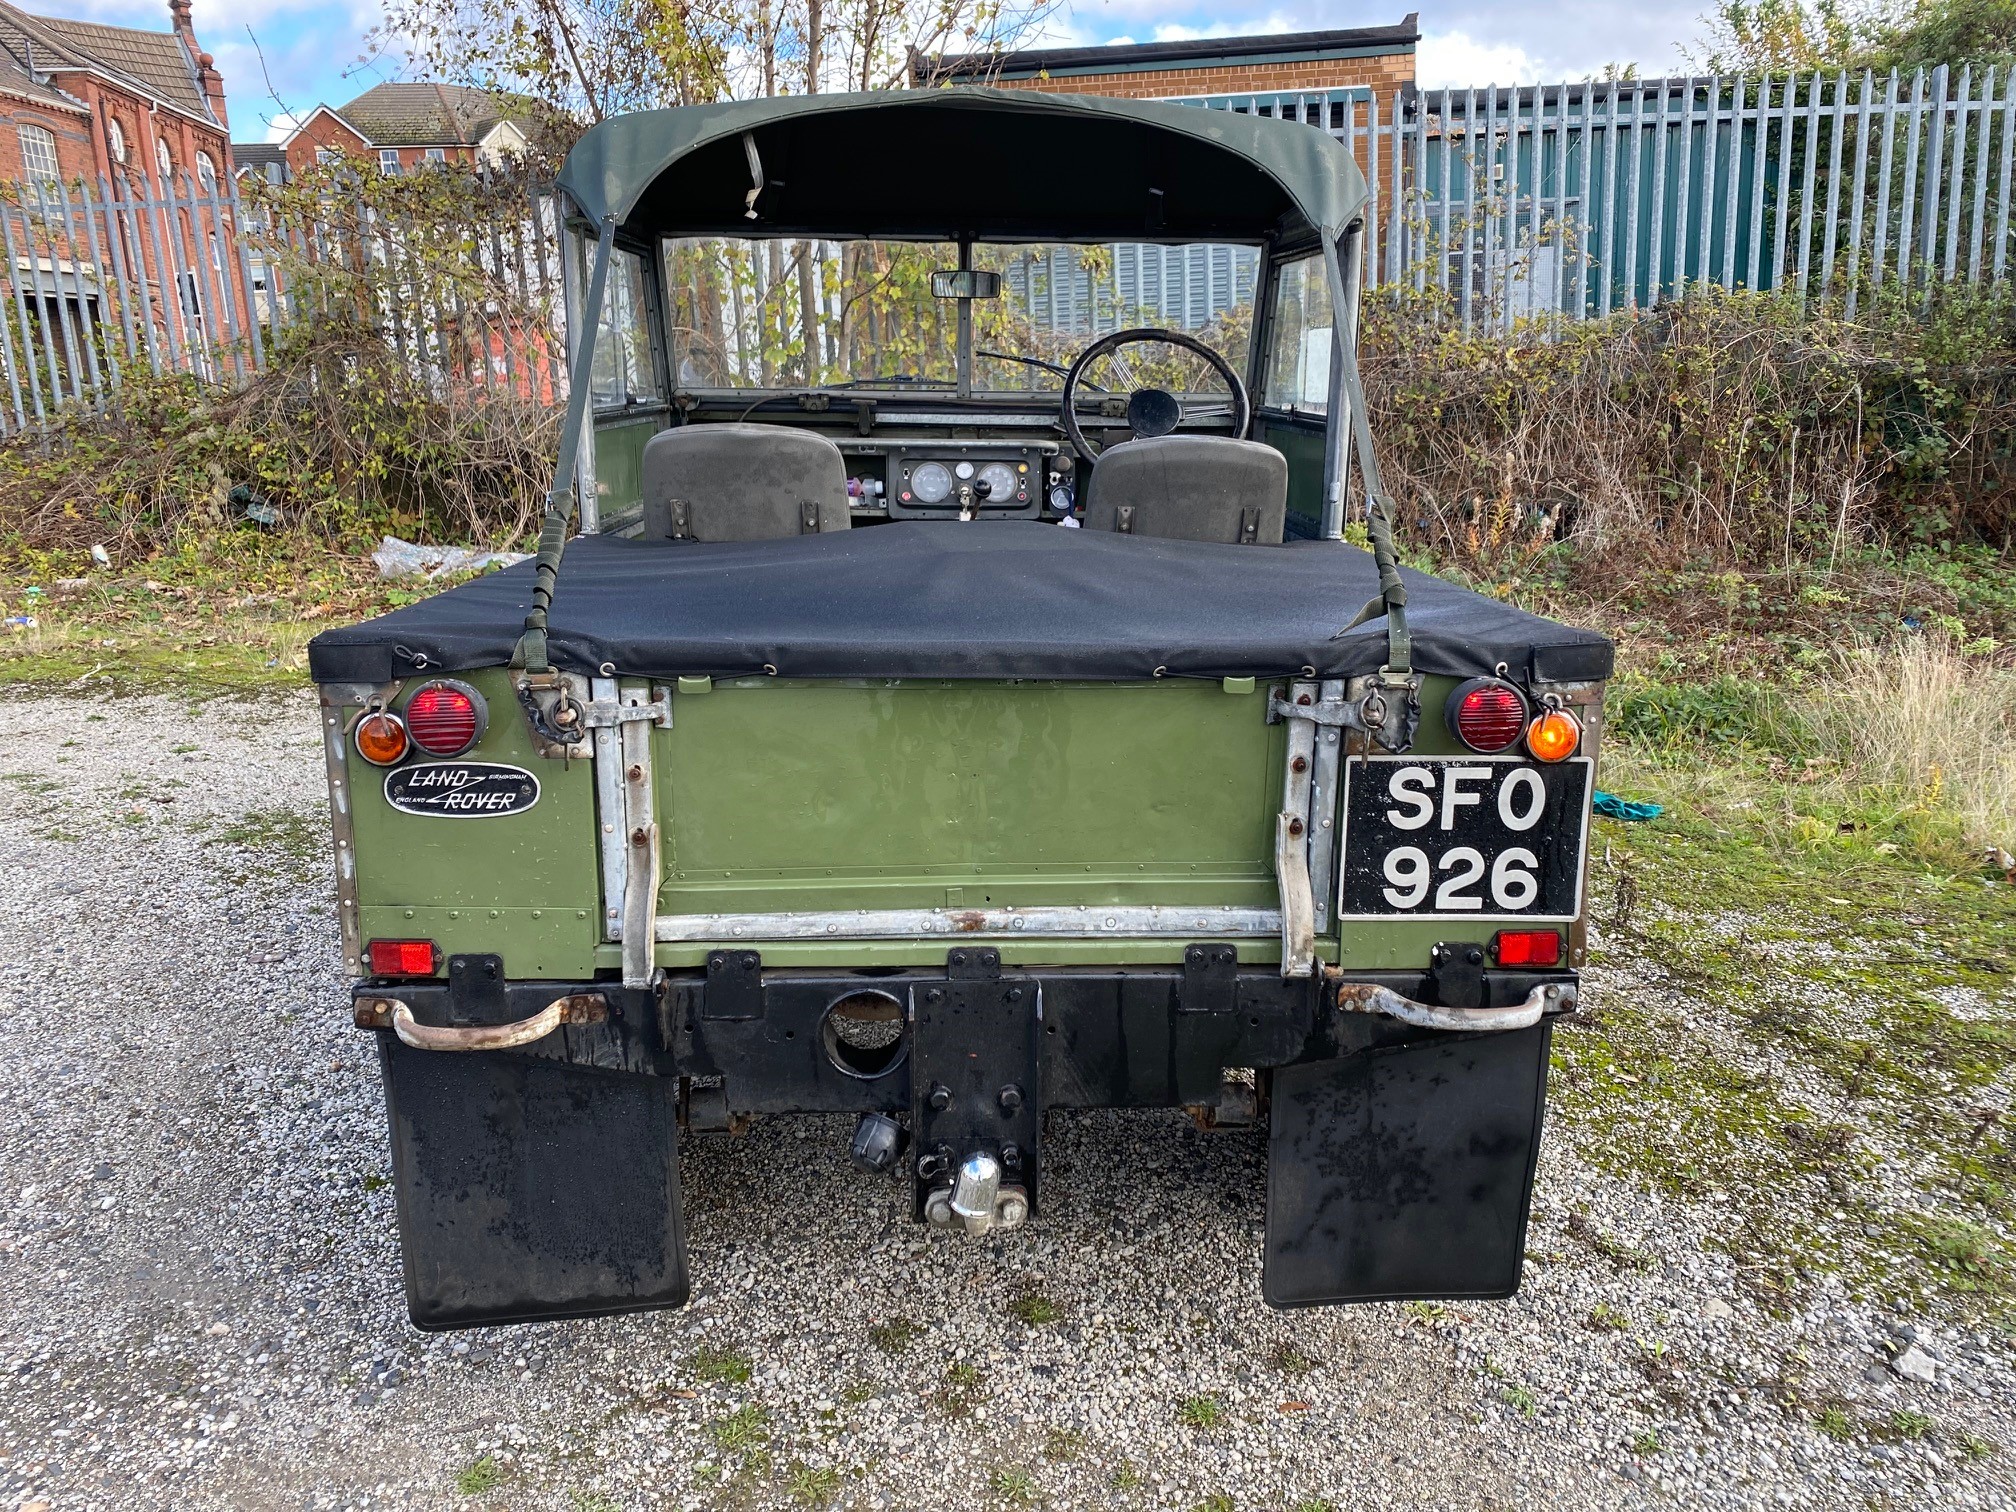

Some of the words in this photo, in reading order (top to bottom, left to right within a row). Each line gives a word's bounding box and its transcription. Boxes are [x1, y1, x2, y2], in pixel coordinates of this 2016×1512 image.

[408, 770, 469, 787] LAND
[443, 793, 516, 810] ROVER
[1382, 846, 1539, 909] 926
